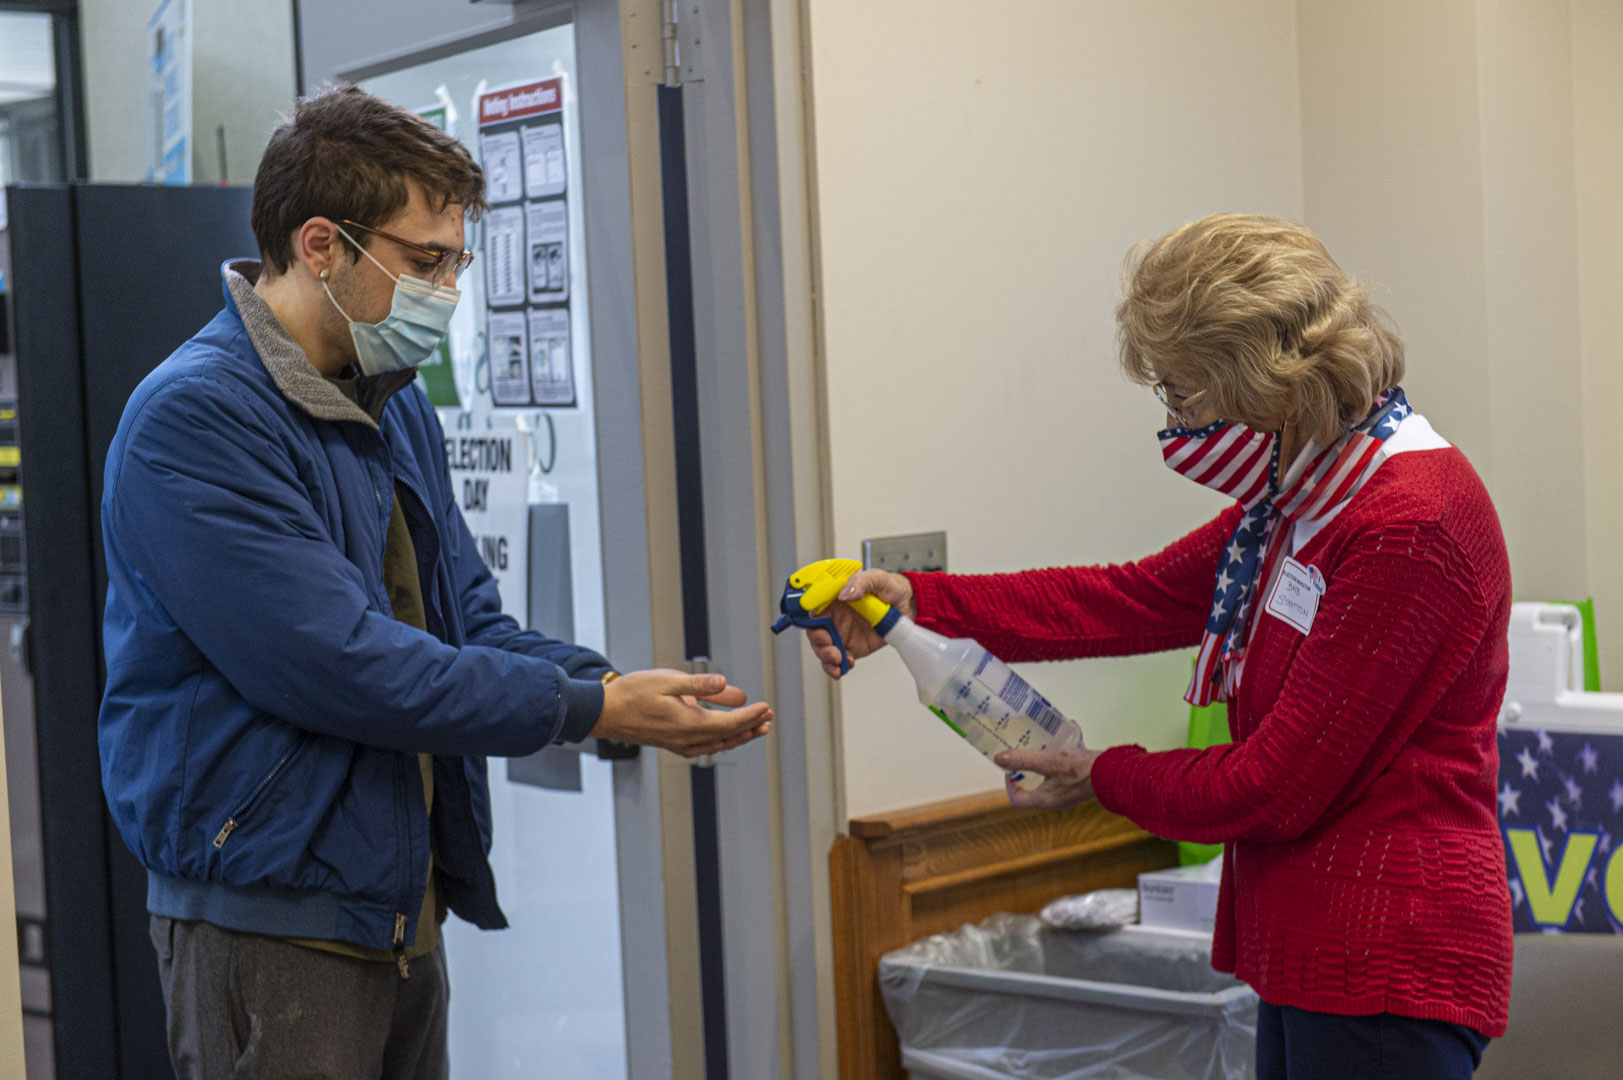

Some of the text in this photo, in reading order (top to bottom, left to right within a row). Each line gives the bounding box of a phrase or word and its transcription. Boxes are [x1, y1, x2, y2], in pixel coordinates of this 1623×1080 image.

[509, 87, 557, 111] Instructions
[464, 479, 488, 511] DAY
[1503, 827, 1623, 930] V
